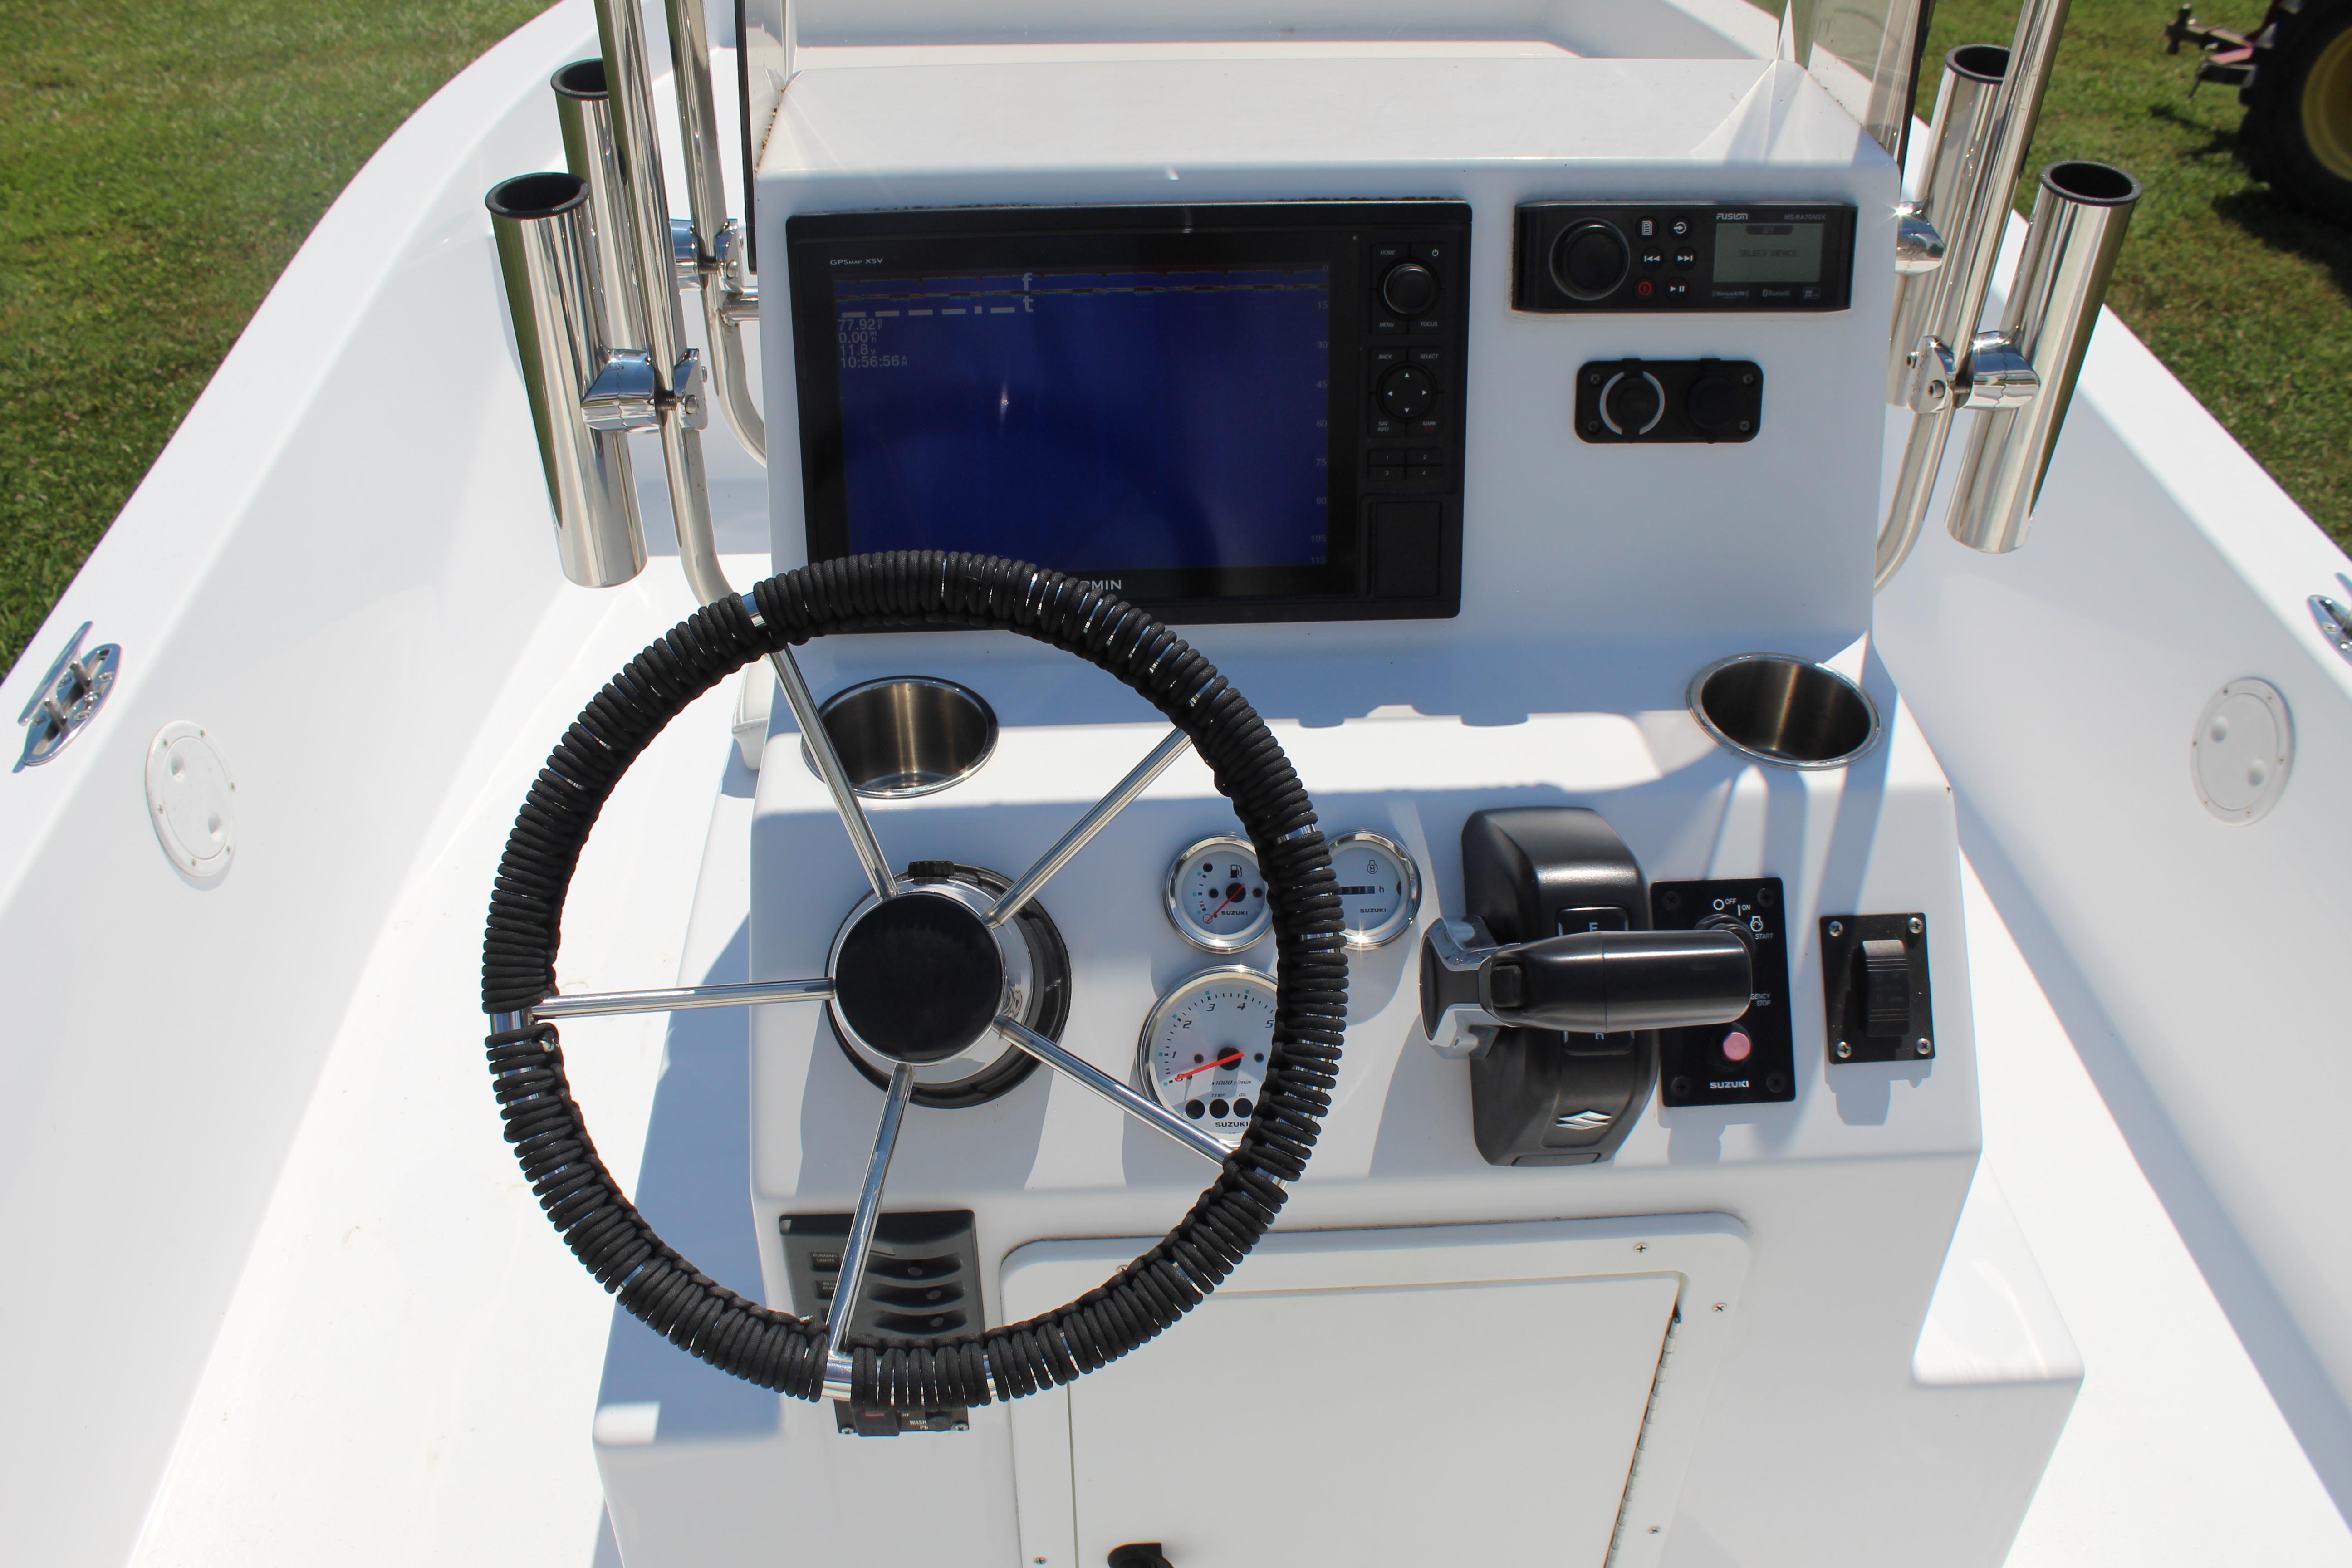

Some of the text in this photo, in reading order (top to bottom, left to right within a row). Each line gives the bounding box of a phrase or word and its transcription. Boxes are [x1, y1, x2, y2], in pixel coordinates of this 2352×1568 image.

[838, 319, 876, 331] 77.92
[838, 332, 868, 343] 0.00
[840, 344, 869, 356] 11.8
[840, 355, 900, 368] 10:56:56
[1091, 580, 1122, 590] MIN
[1182, 1020, 1192, 1029] 2
[1265, 1020, 1274, 1028] 5
[1709, 1081, 1749, 1089] SUZUKI
